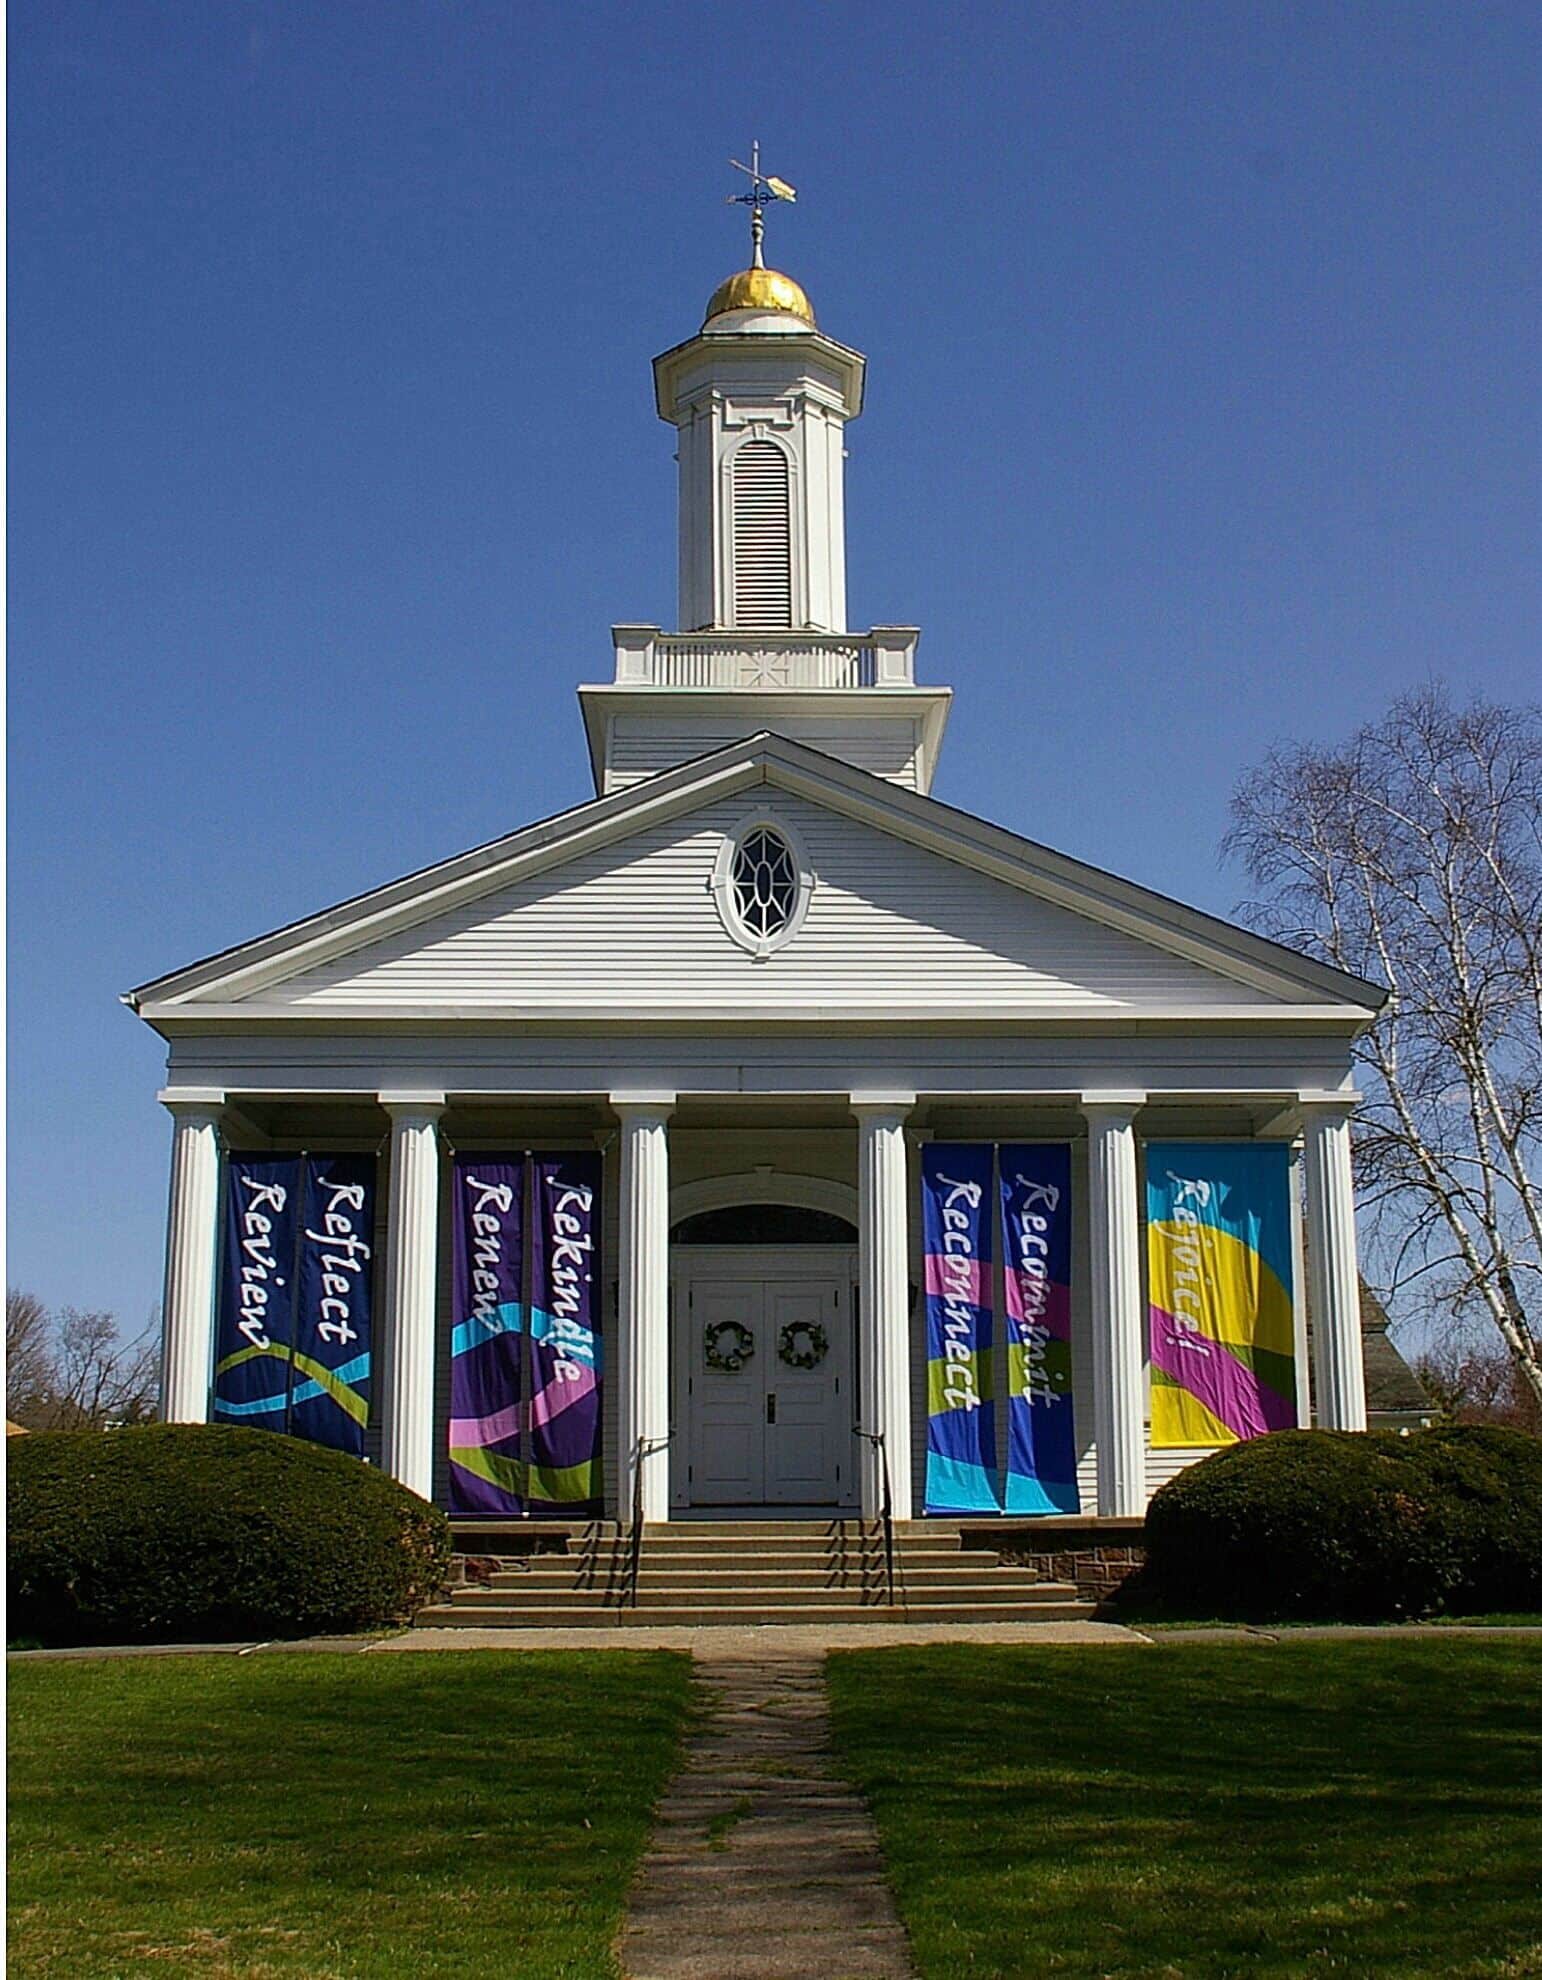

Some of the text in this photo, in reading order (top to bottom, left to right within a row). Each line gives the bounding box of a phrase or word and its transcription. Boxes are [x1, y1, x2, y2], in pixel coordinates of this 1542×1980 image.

[238, 1175, 285, 1349] Review
[305, 1176, 370, 1345] Reflect
[466, 1175, 512, 1335] Renew
[539, 1175, 594, 1384] Rekindle
[936, 1173, 981, 1412] Reconnect
[1016, 1173, 1060, 1408] Recommit
[1155, 1170, 1212, 1356] Rejoice!
